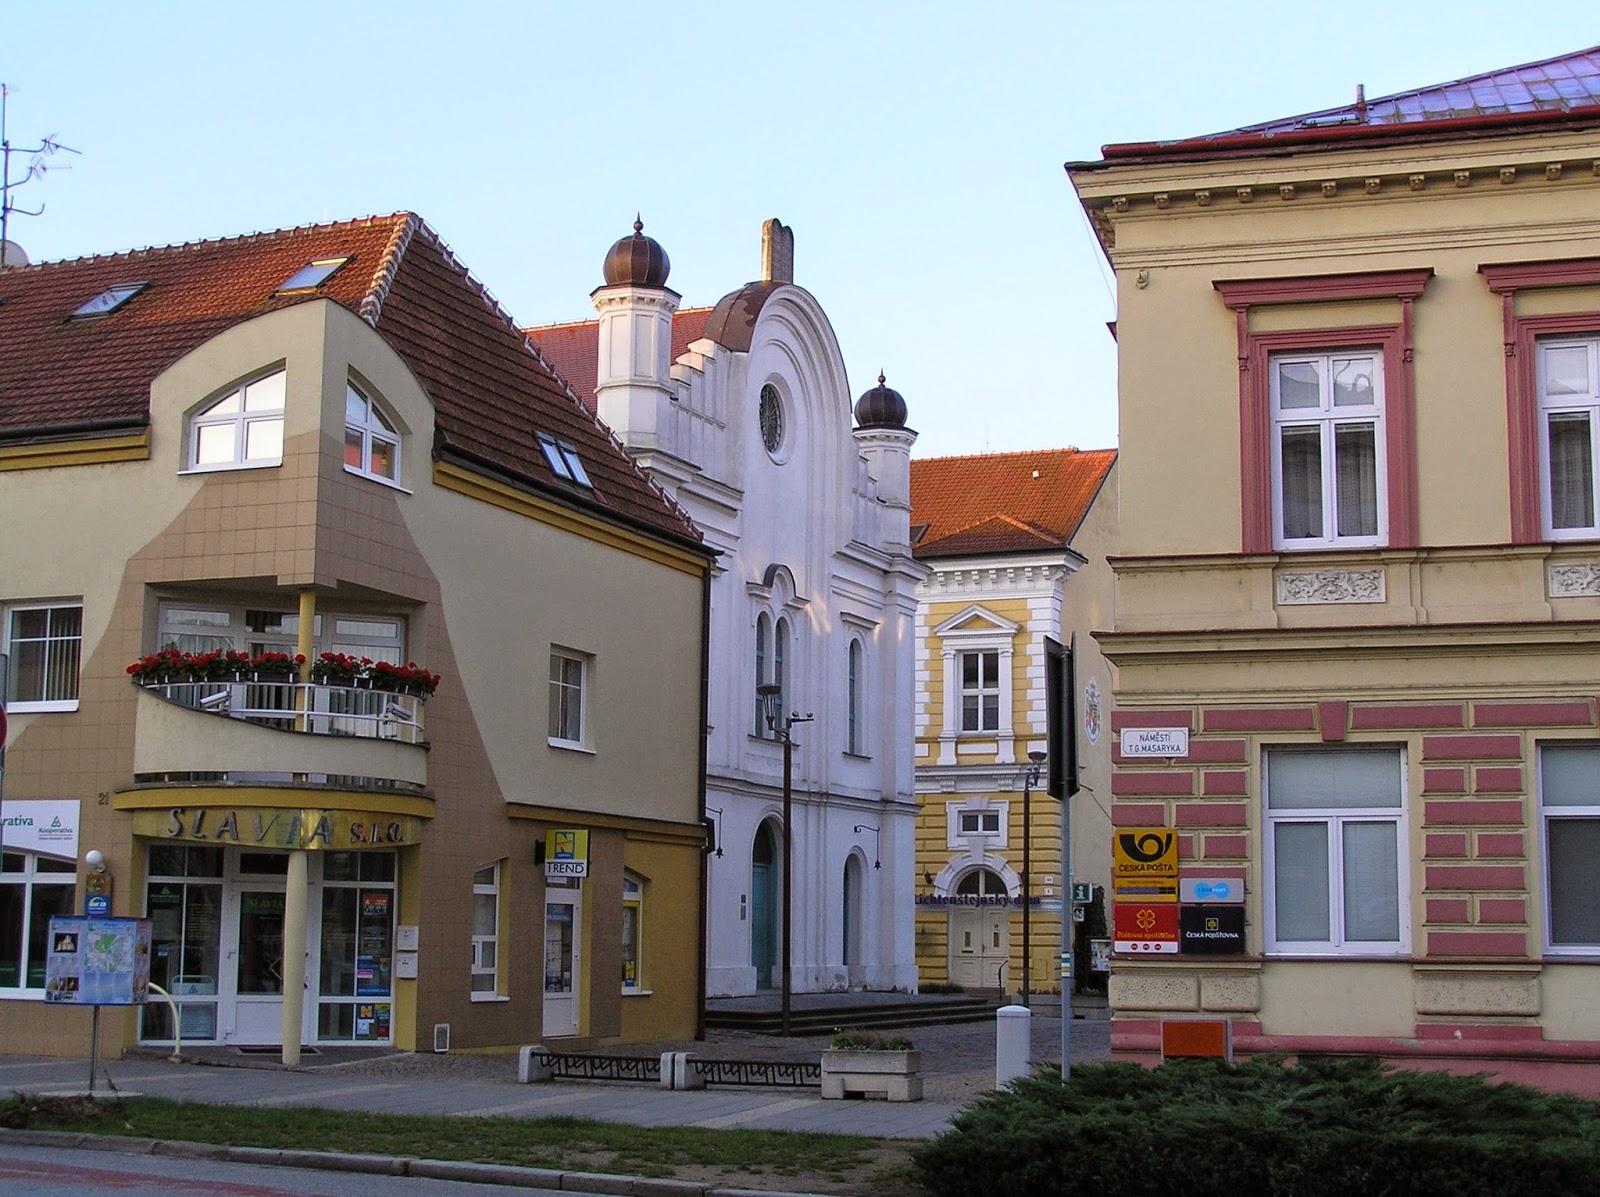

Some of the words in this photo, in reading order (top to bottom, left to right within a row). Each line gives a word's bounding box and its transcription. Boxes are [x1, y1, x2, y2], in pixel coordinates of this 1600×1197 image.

[1139, 732, 1171, 742] NÁMĚSTÍ
[98, 792, 109, 805] 21
[167, 807, 332, 844] SLAVIA
[38, 827, 73, 835] Kooperativa
[546, 862, 584, 874] TREND
[1119, 863, 1145, 872] ČESKÁ
[1146, 863, 1173, 872] POŠTA
[1013, 894, 1040, 905] dm
[1185, 930, 1205, 938] ČESKÁ
